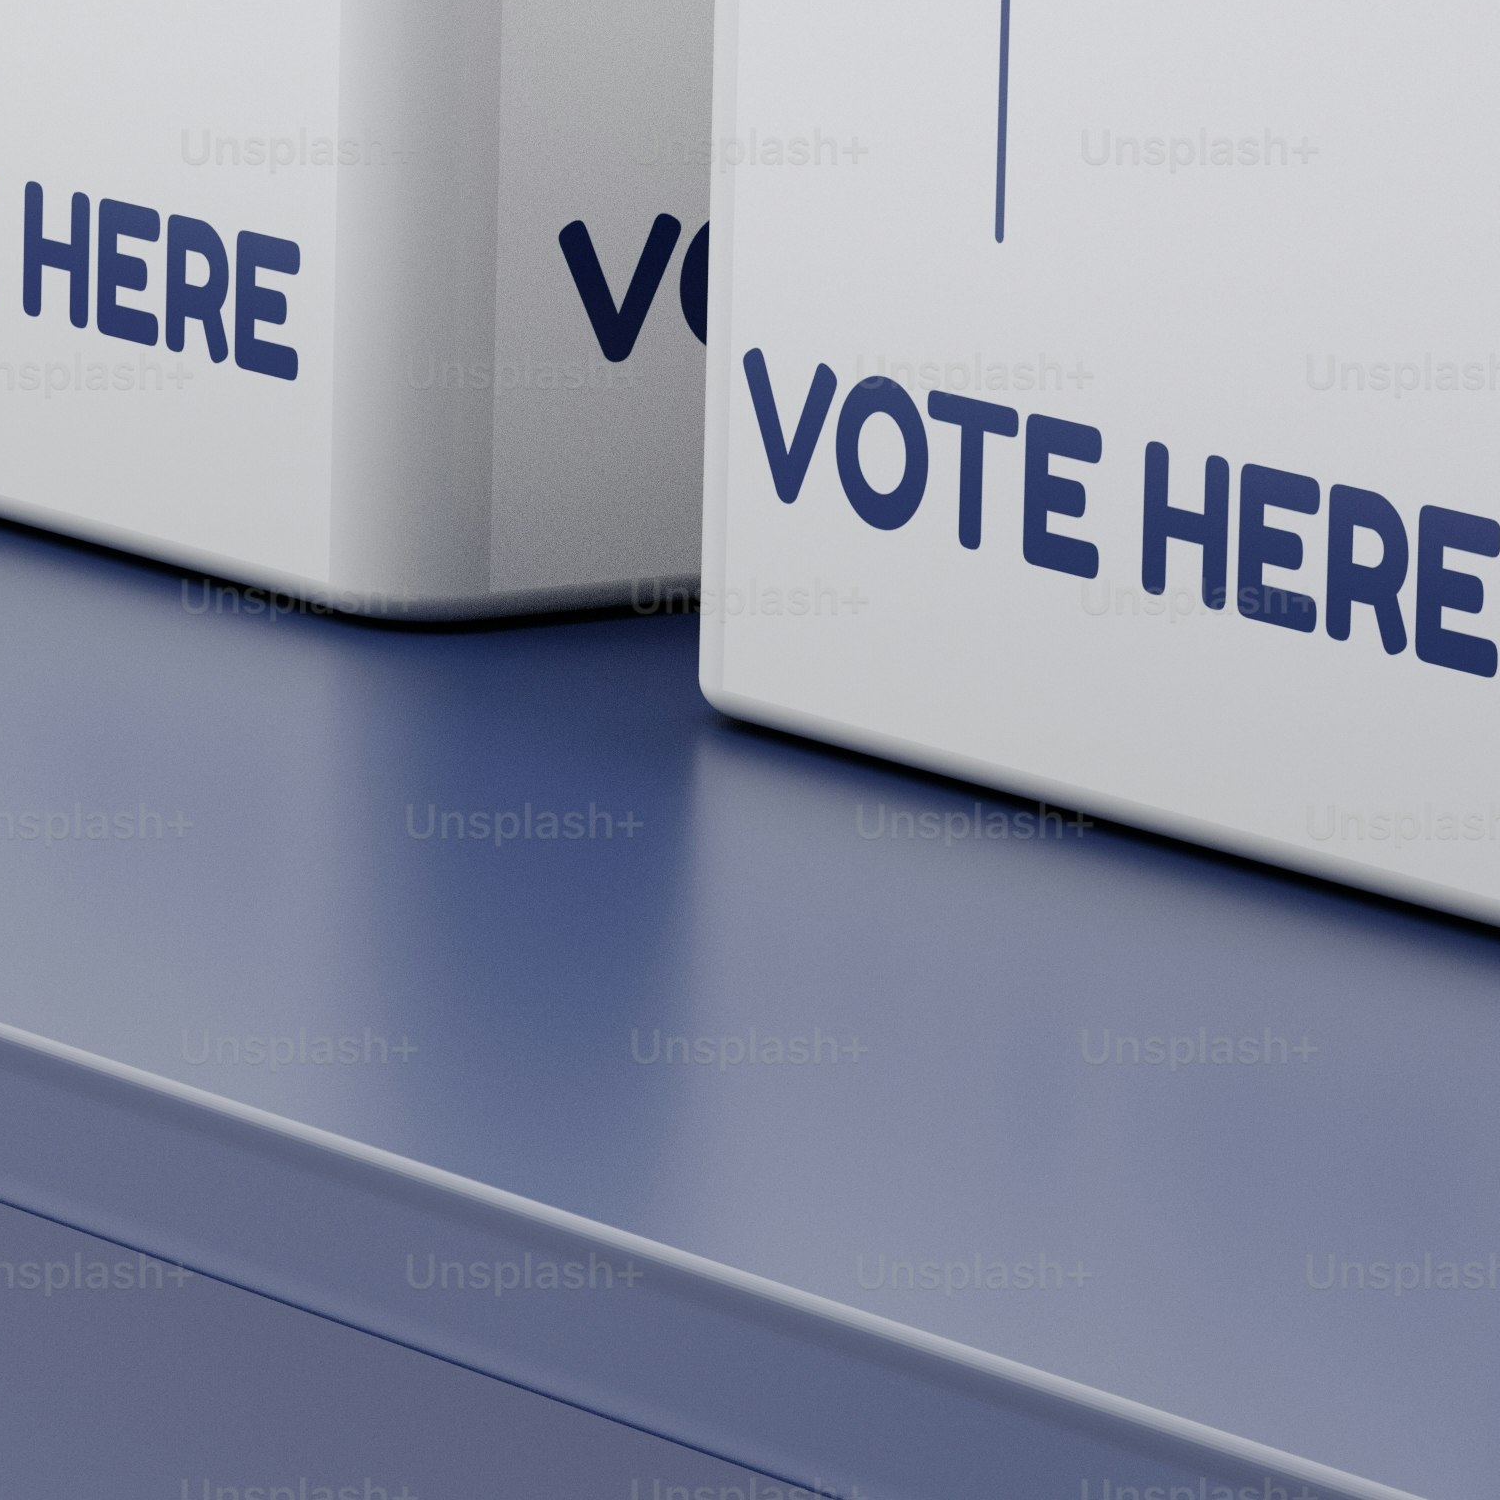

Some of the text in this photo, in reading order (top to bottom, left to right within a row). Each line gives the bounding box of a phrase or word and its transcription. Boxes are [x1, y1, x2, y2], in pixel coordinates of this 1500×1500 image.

[23, 181, 300, 380] HERE
[743, 348, 1500, 678] VOTE HERE
